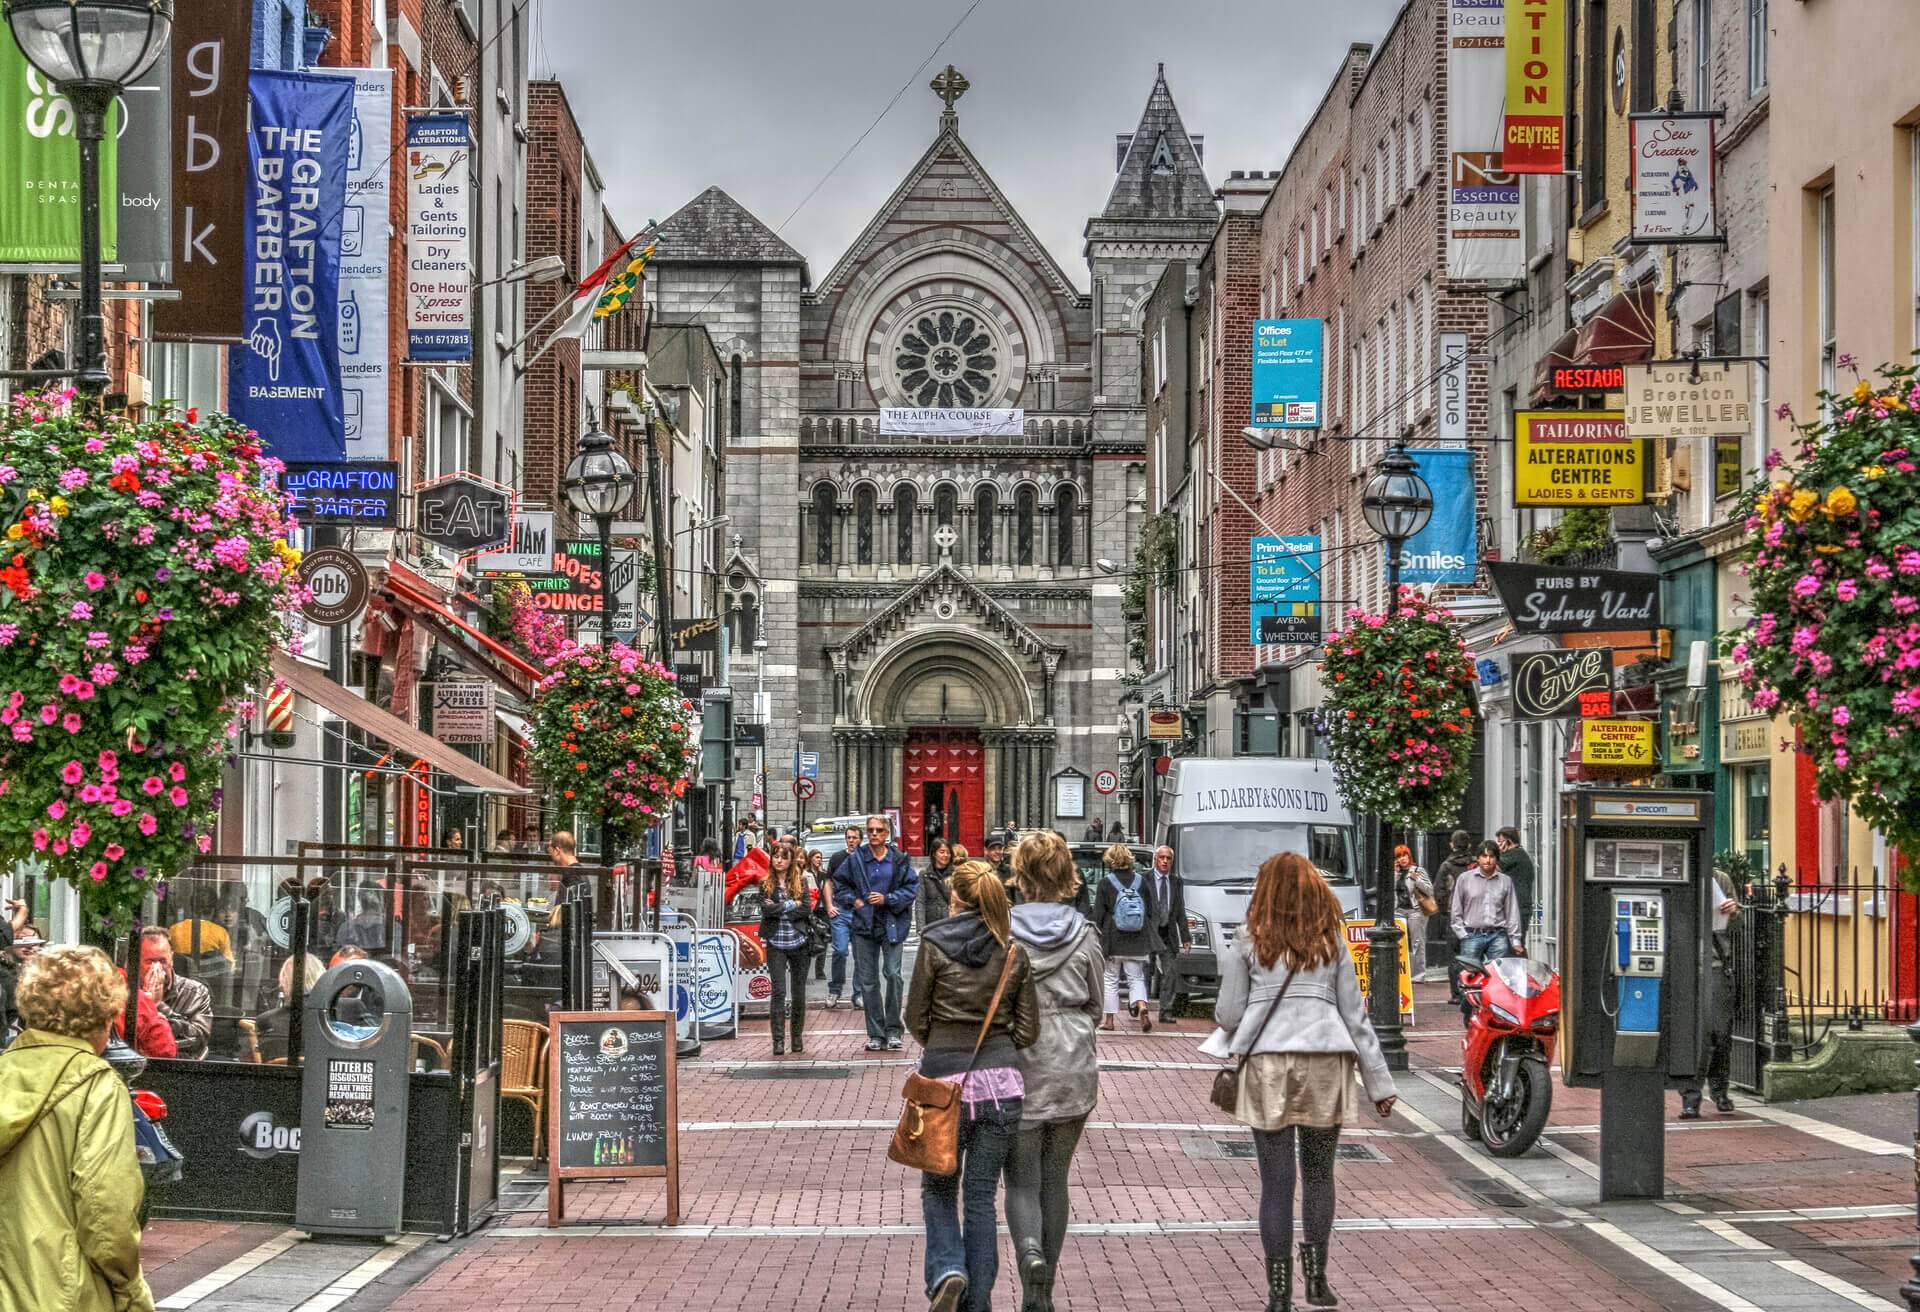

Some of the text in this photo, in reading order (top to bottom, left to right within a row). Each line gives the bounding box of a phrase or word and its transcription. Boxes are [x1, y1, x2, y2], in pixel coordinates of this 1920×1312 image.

[1453, 12, 1504, 25] Beau
[1459, 38, 1504, 47] 67164
[1524, 0, 1548, 104] TION
[355, 82, 385, 92] nders
[1508, 125, 1560, 144] CENTRE
[1653, 120, 1693, 141] Sew
[260, 127, 322, 152] THE
[410, 136, 466, 144] ALTERATIONS
[1642, 140, 1699, 158] Creative
[26, 181, 79, 189] DENTA
[347, 179, 384, 189] enders
[418, 184, 459, 194] Ladies
[39, 195, 77, 203] SPAS
[1452, 188, 1519, 202] Essence
[122, 193, 161, 210] body
[435, 198, 443, 208] &
[420, 211, 458, 222] Gents
[1450, 208, 1517, 224] Beauty
[254, 157, 284, 311] BARBER
[411, 225, 466, 237] Tailoring
[289, 158, 321, 339] GRAFTON
[427, 247, 450, 259] Dry
[411, 260, 466, 271] Cleaners
[410, 282, 468, 293] One Hour
[416, 295, 462, 309] Xpress
[415, 312, 464, 322] Services
[1258, 326, 1292, 335] Offices
[411, 335, 469, 344] Ph: 01 6717813
[1259, 338, 1287, 346] To Let
[1555, 369, 1623, 388] RESTAUR
[1653, 369, 1723, 383] Loran
[249, 386, 325, 399] BASEMENT
[1643, 388, 1734, 402] Brereton
[887, 411, 992, 420] THE ALPHA COURSE
[1627, 403, 1750, 425] JEWELLER
[1537, 423, 1624, 438] TAILORING
[1528, 448, 1635, 464] ALTERATIONS
[307, 471, 393, 489] GRAFTON
[1551, 468, 1611, 484] CENTRE
[1528, 488, 1635, 499] LADIES & GENTS
[423, 495, 501, 537] EAT
[568, 543, 602, 555] WINE
[1256, 543, 1313, 552] Prime Retail
[303, 555, 358, 576] gourmet burger
[518, 556, 543, 566] CAFÉ
[1400, 550, 1466, 570] Smiles
[554, 553, 601, 589] HOES
[1257, 566, 1285, 575] To Let
[312, 574, 347, 597] gbk
[531, 579, 570, 589] SPIRITS
[1536, 576, 1600, 590] FURS BY
[535, 593, 603, 611] OUNGE
[314, 608, 345, 617] kitchen
[1516, 591, 1655, 629] Sydney Vard
[1276, 617, 1306, 625] AVEDA
[1264, 632, 1318, 641] WHETSTONE
[1515, 650, 1609, 716] Cave
[1581, 703, 1611, 716] BAR
[1591, 725, 1644, 733] ALTERATION
[1100, 776, 1111, 785] 50
[1304, 790, 1328, 812] LTD
[330, 1061, 373, 1073] LITTER IS
[329, 1073, 373, 1082] DISGUSTING
[329, 1091, 372, 1100] RESPONSIBLE
